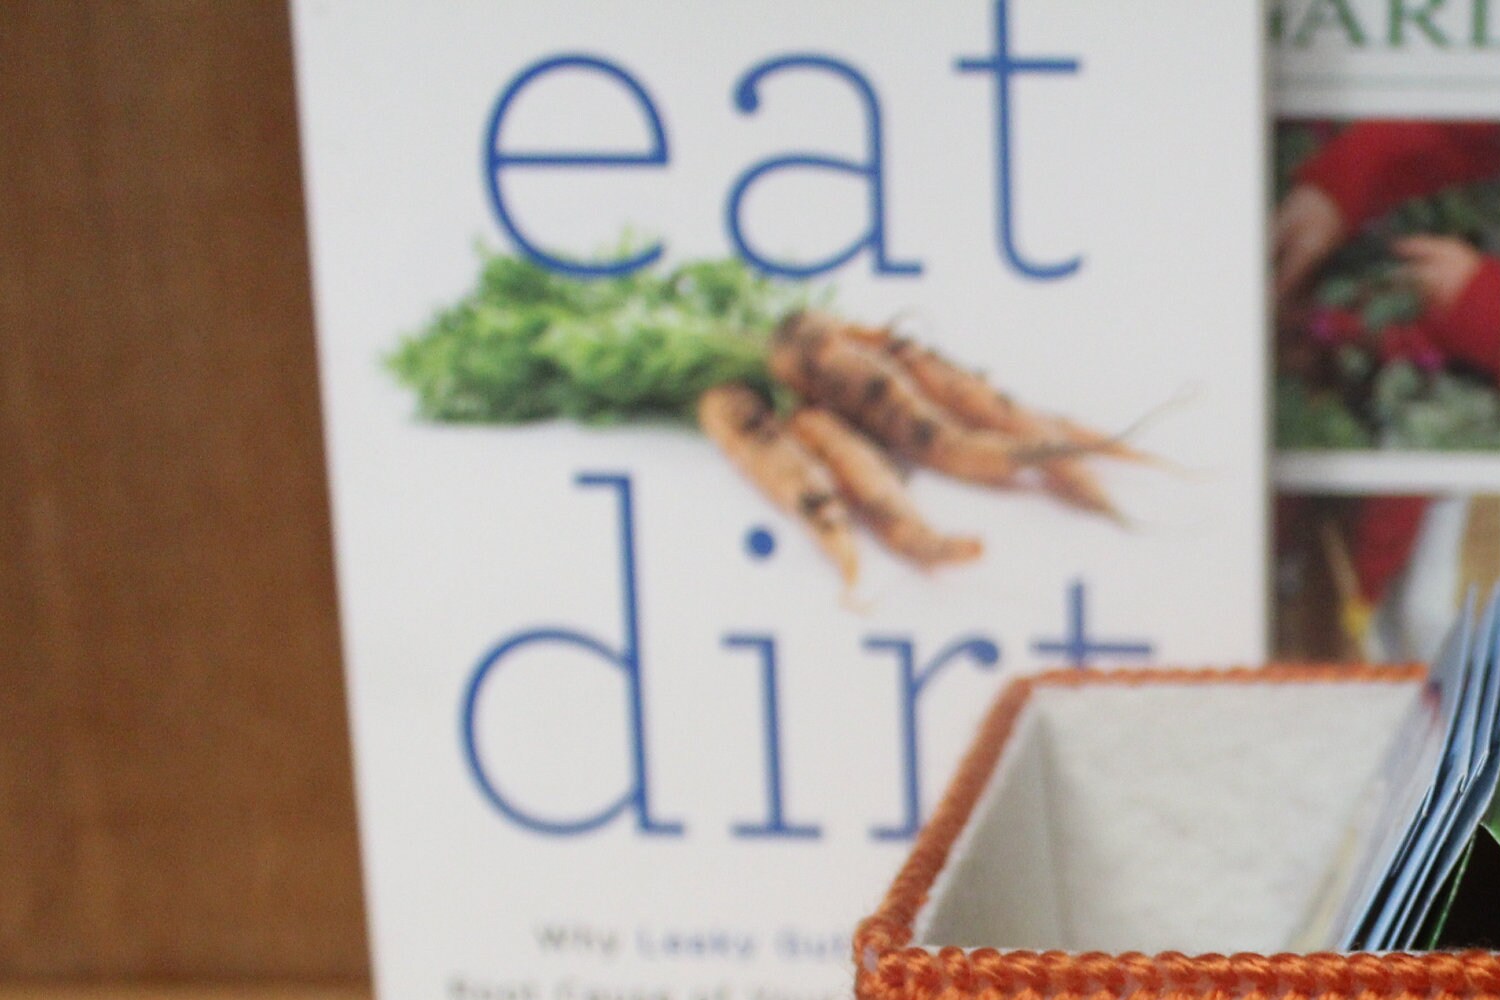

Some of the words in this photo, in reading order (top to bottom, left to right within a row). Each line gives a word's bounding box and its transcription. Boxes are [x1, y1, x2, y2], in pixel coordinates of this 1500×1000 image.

[482, 0, 1084, 280] eat
[537, 924, 617, 957] Why
[635, 926, 756, 960] Leaky
